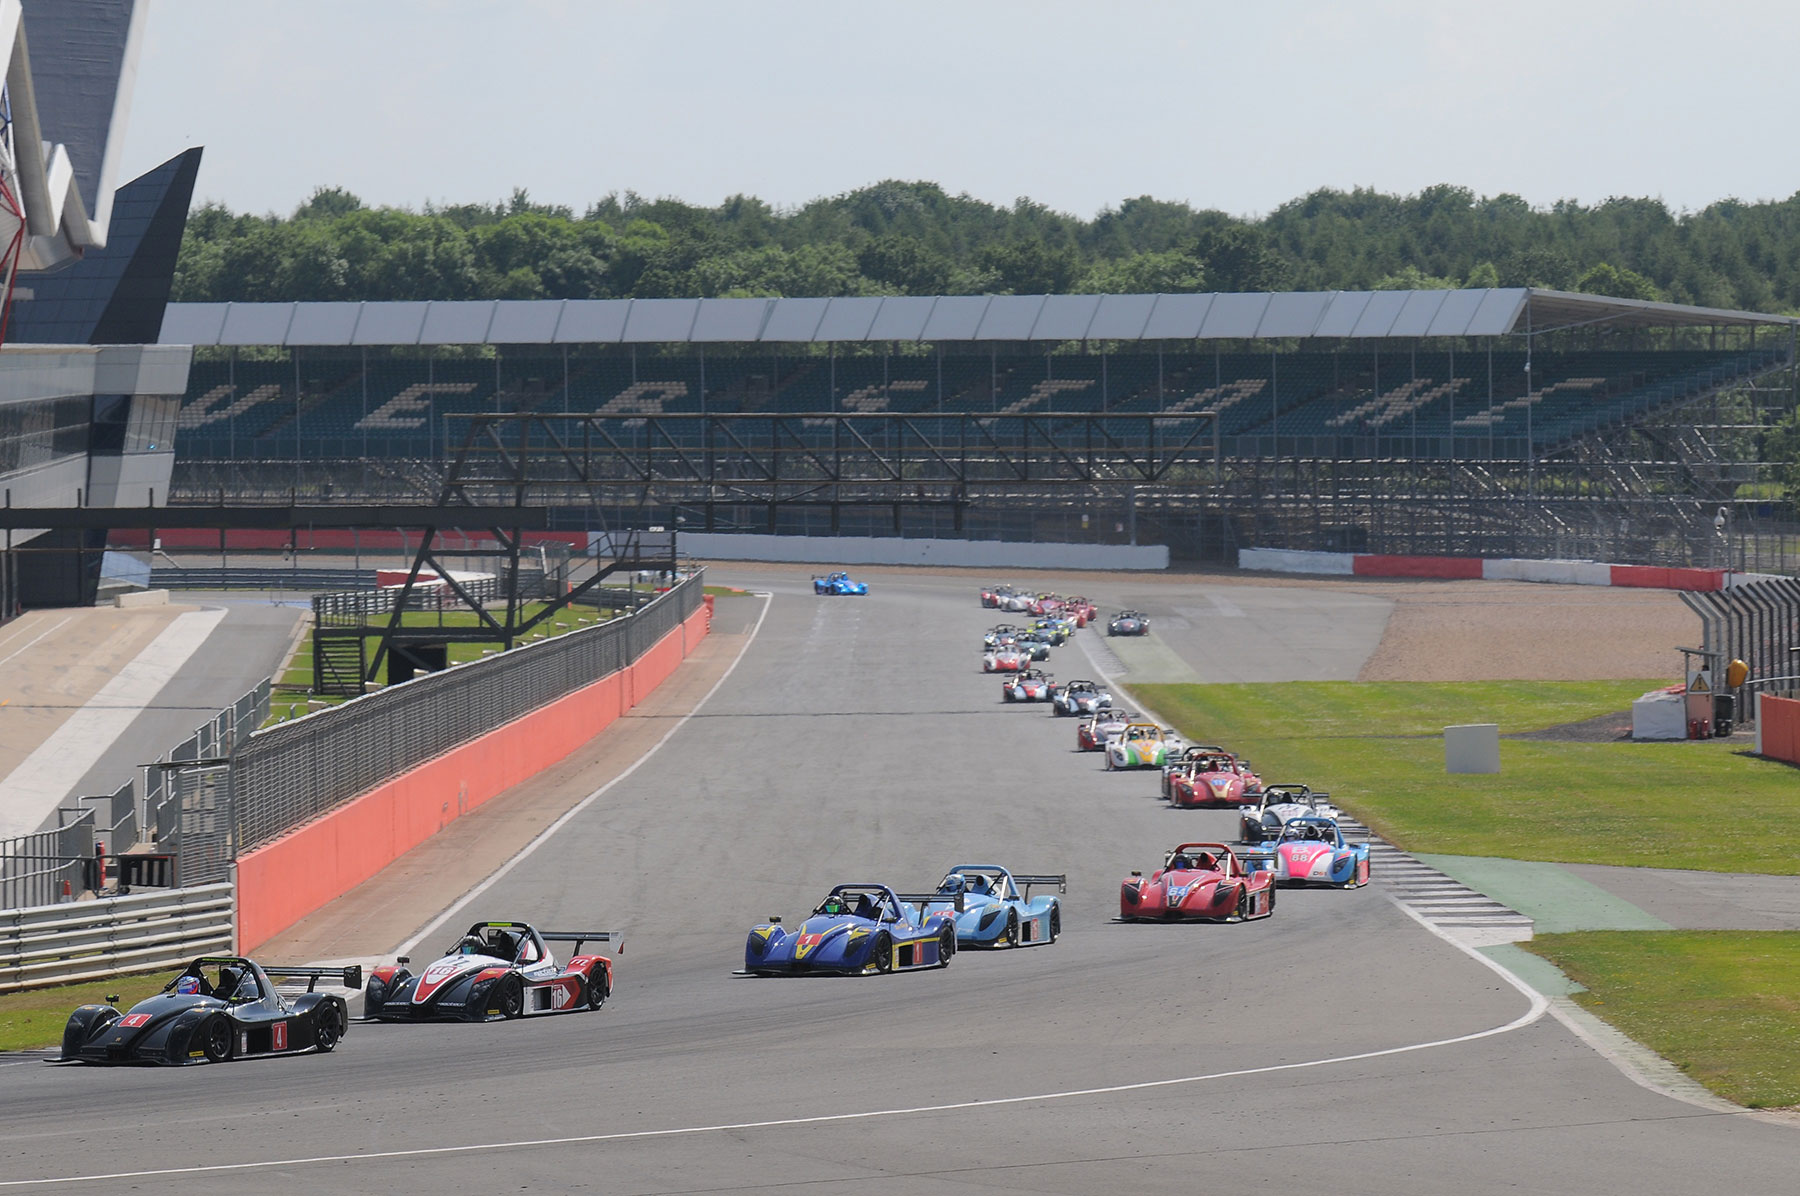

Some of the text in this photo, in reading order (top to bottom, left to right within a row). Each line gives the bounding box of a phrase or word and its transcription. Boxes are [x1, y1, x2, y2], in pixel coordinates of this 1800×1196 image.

[1291, 853, 1308, 863] 88
[429, 966, 458, 976] 16
[552, 988, 564, 1010] 16
